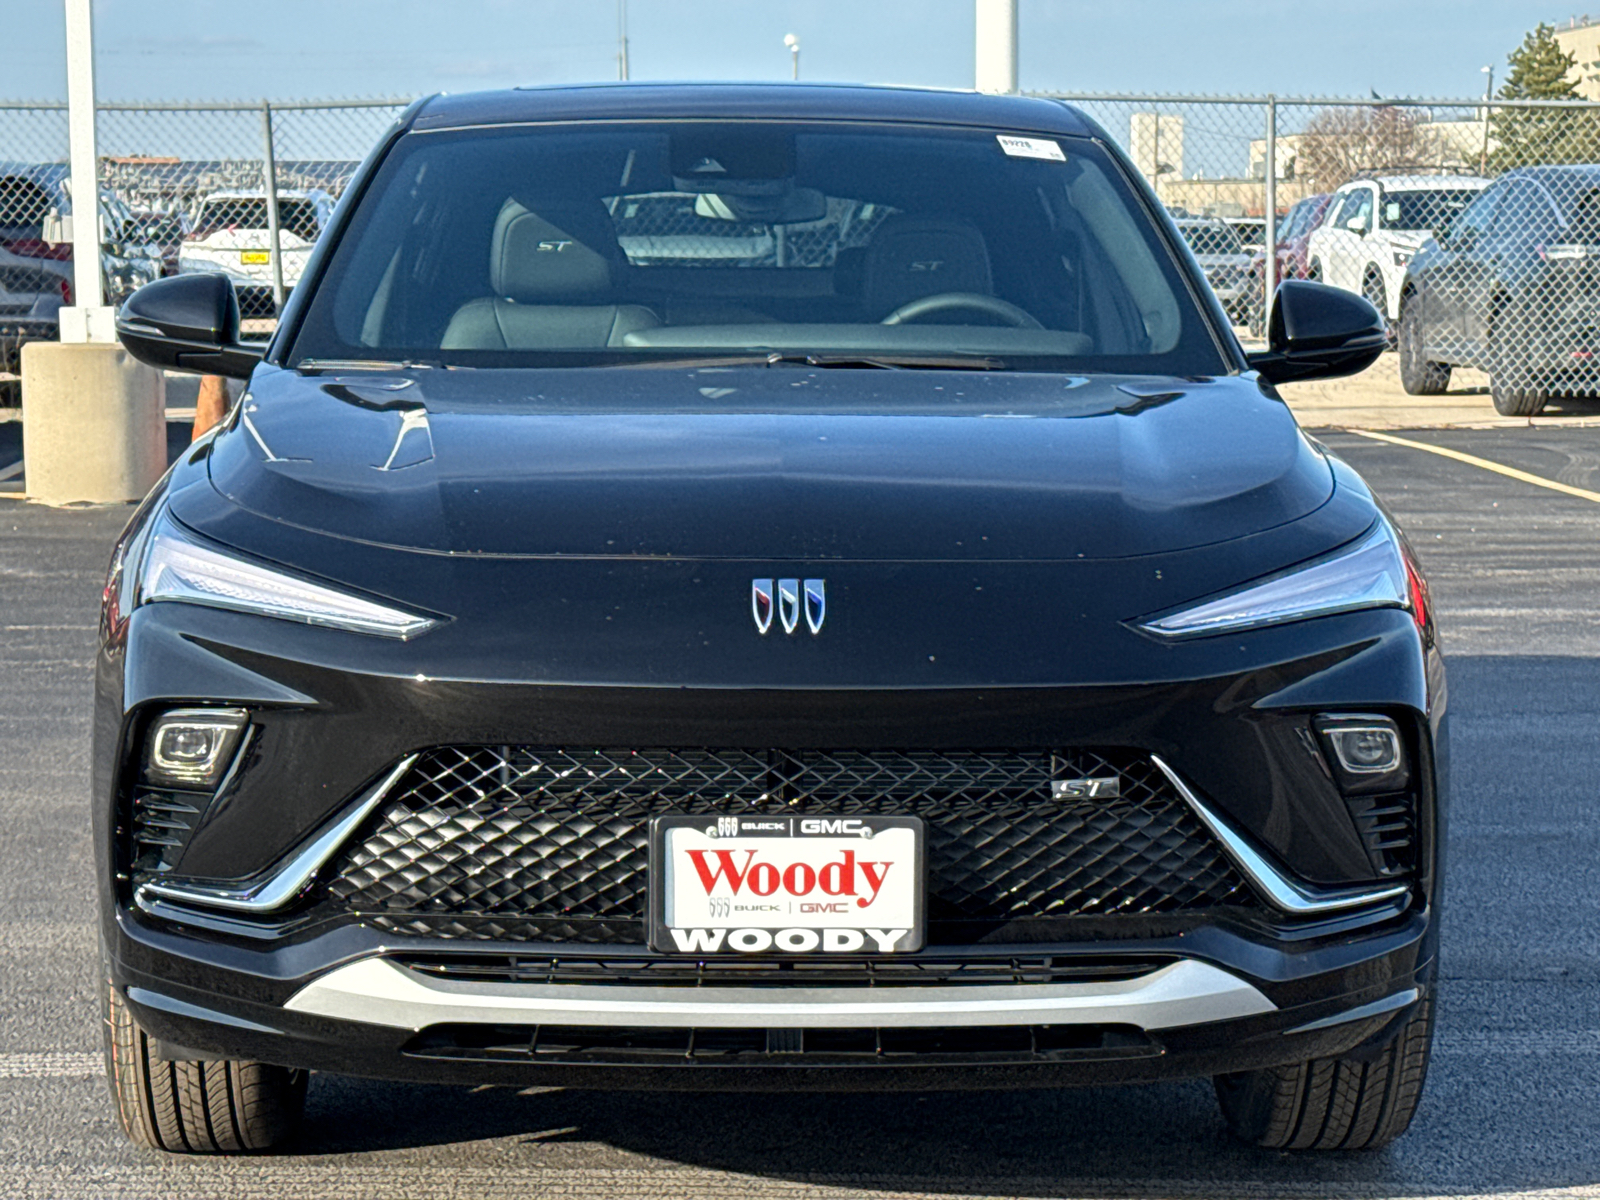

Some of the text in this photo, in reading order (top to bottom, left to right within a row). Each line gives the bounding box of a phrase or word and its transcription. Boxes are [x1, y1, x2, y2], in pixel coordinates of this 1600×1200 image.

[536, 241, 573, 252] ST
[909, 260, 944, 272] ST
[1055, 779, 1114, 799] ST
[741, 819, 863, 834] BUICK GMC
[684, 849, 895, 909] Woody
[734, 902, 849, 914] BUICK GMC
[670, 928, 908, 952] WOODY
